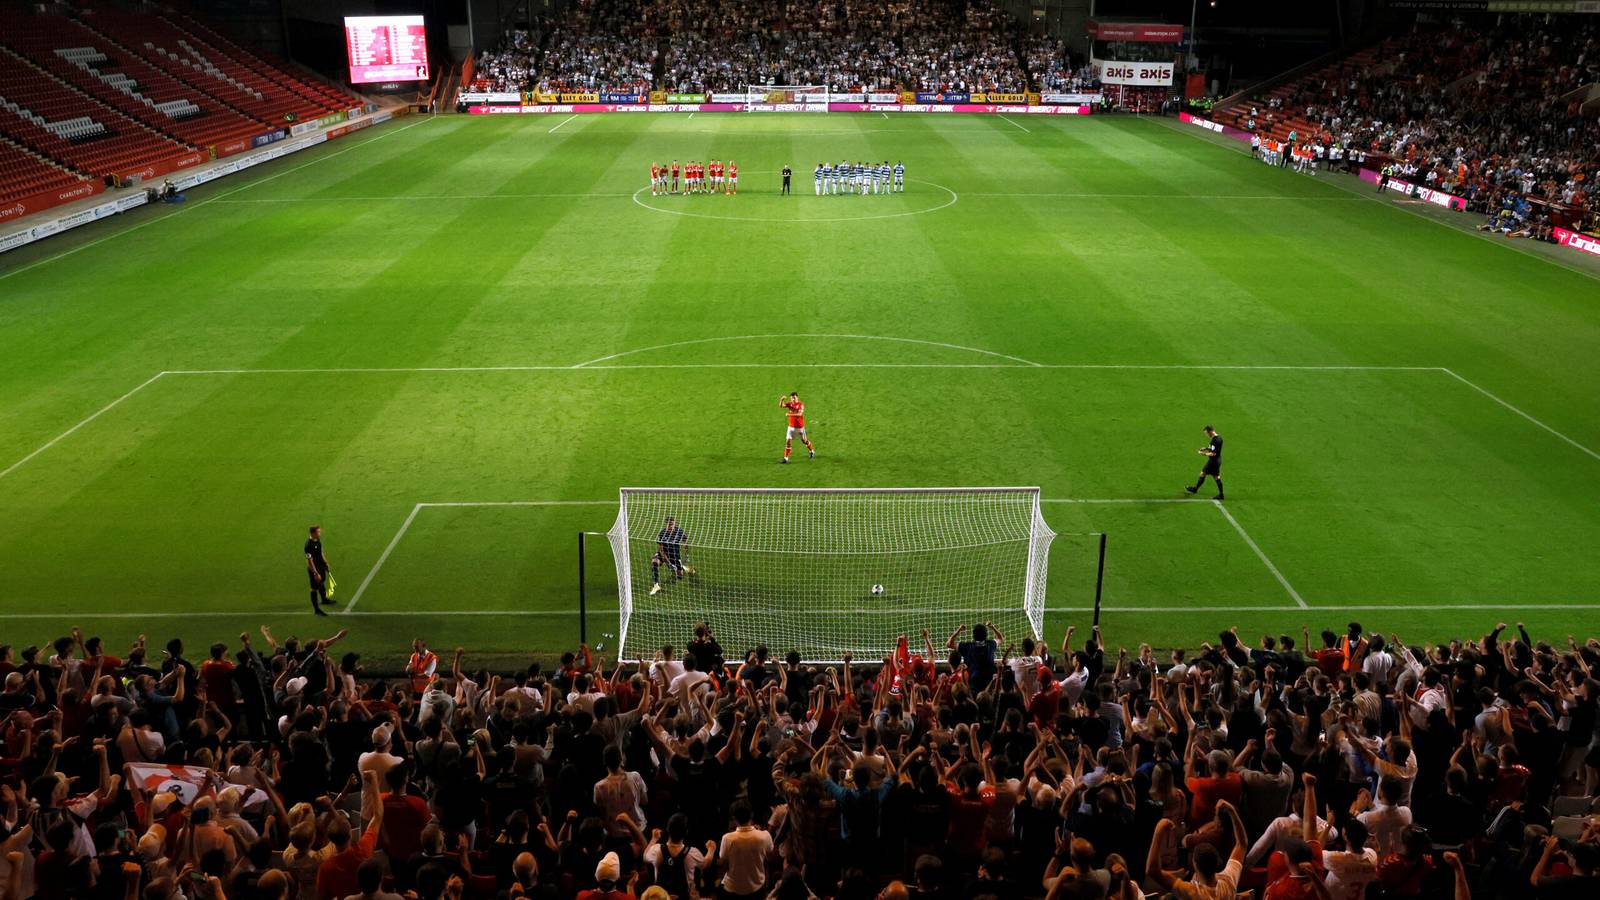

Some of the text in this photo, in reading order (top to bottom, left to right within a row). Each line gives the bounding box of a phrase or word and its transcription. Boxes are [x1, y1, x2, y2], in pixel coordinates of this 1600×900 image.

[1106, 65, 1134, 79] axis
[1140, 66, 1171, 80] axis
[489, 105, 574, 113] Carabao ENERGY DRINK
[616, 104, 700, 112] Carabao ENERGY DRINK
[870, 103, 954, 112] Carabao ENERGY DRINK
[996, 105, 1080, 113] Carabao ENERGY DRINK
[1430, 190, 1452, 206] DRINK
